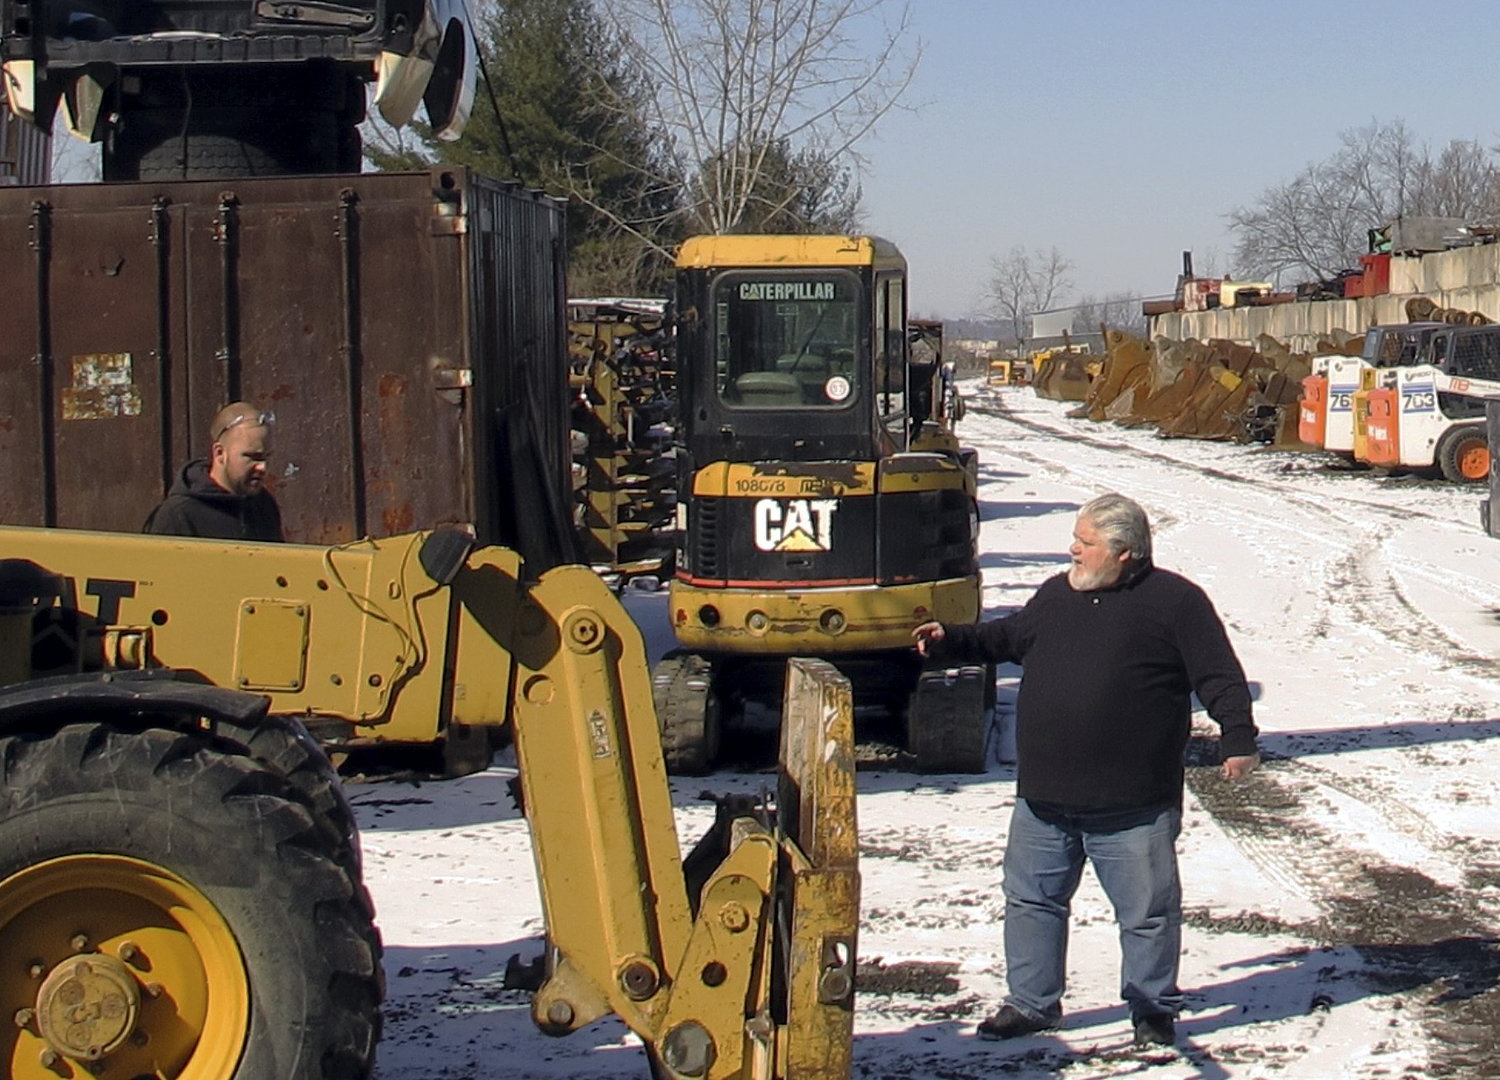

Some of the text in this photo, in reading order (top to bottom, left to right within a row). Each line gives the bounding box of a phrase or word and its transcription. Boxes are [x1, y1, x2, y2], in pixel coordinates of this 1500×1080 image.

[739, 282, 835, 301] CATERPILLAR
[1331, 394, 1354, 408] 76
[754, 497, 840, 552] CAT
